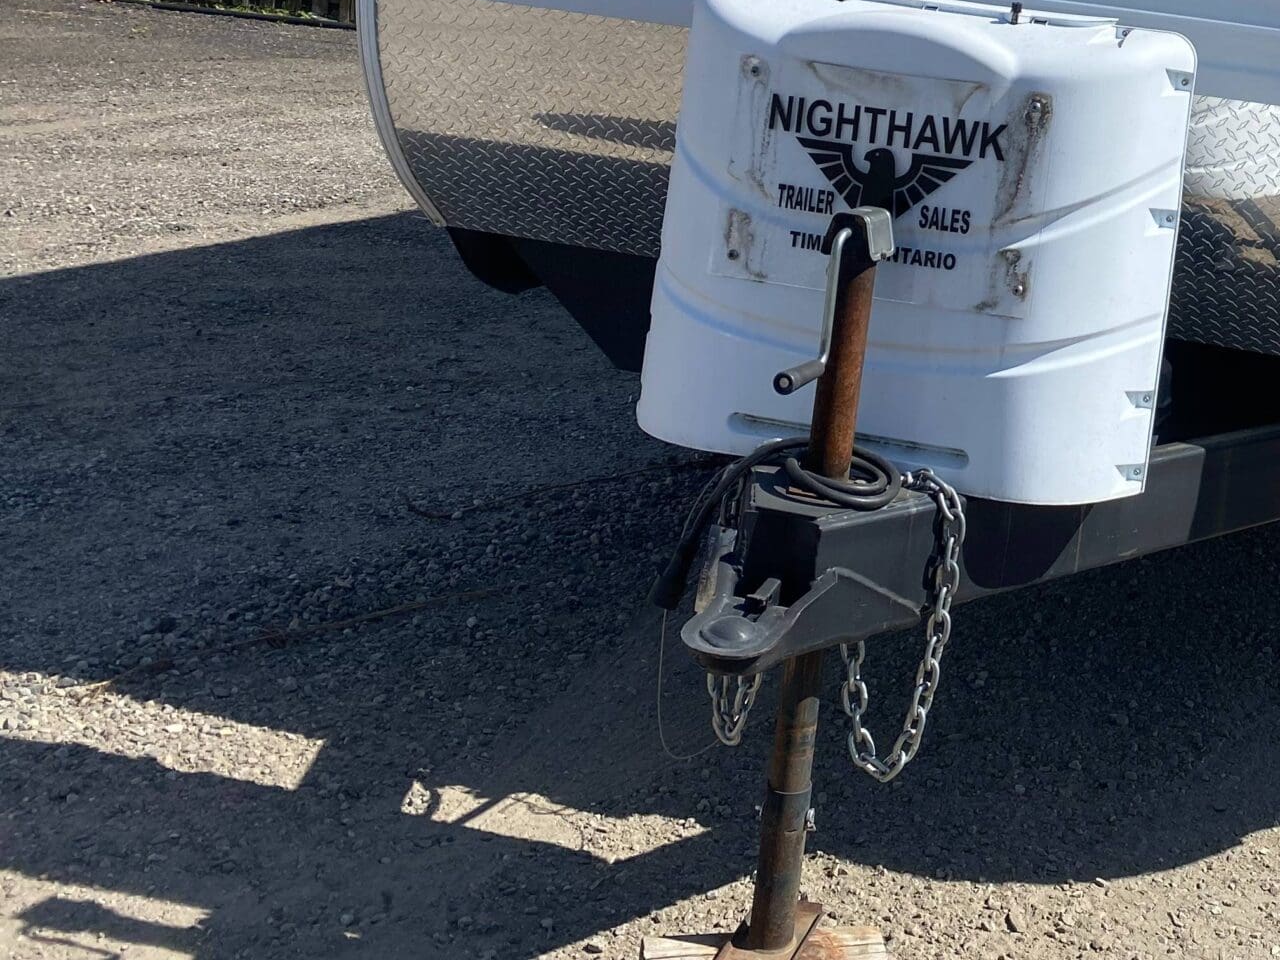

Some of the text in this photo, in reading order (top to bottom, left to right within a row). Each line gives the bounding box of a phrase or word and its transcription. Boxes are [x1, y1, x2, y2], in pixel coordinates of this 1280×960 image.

[768, 93, 1008, 162] NIGHTHAWK
[777, 183, 835, 216] TRAILER
[918, 204, 971, 235] SALES
[789, 230, 956, 271] TIM NTARIO
